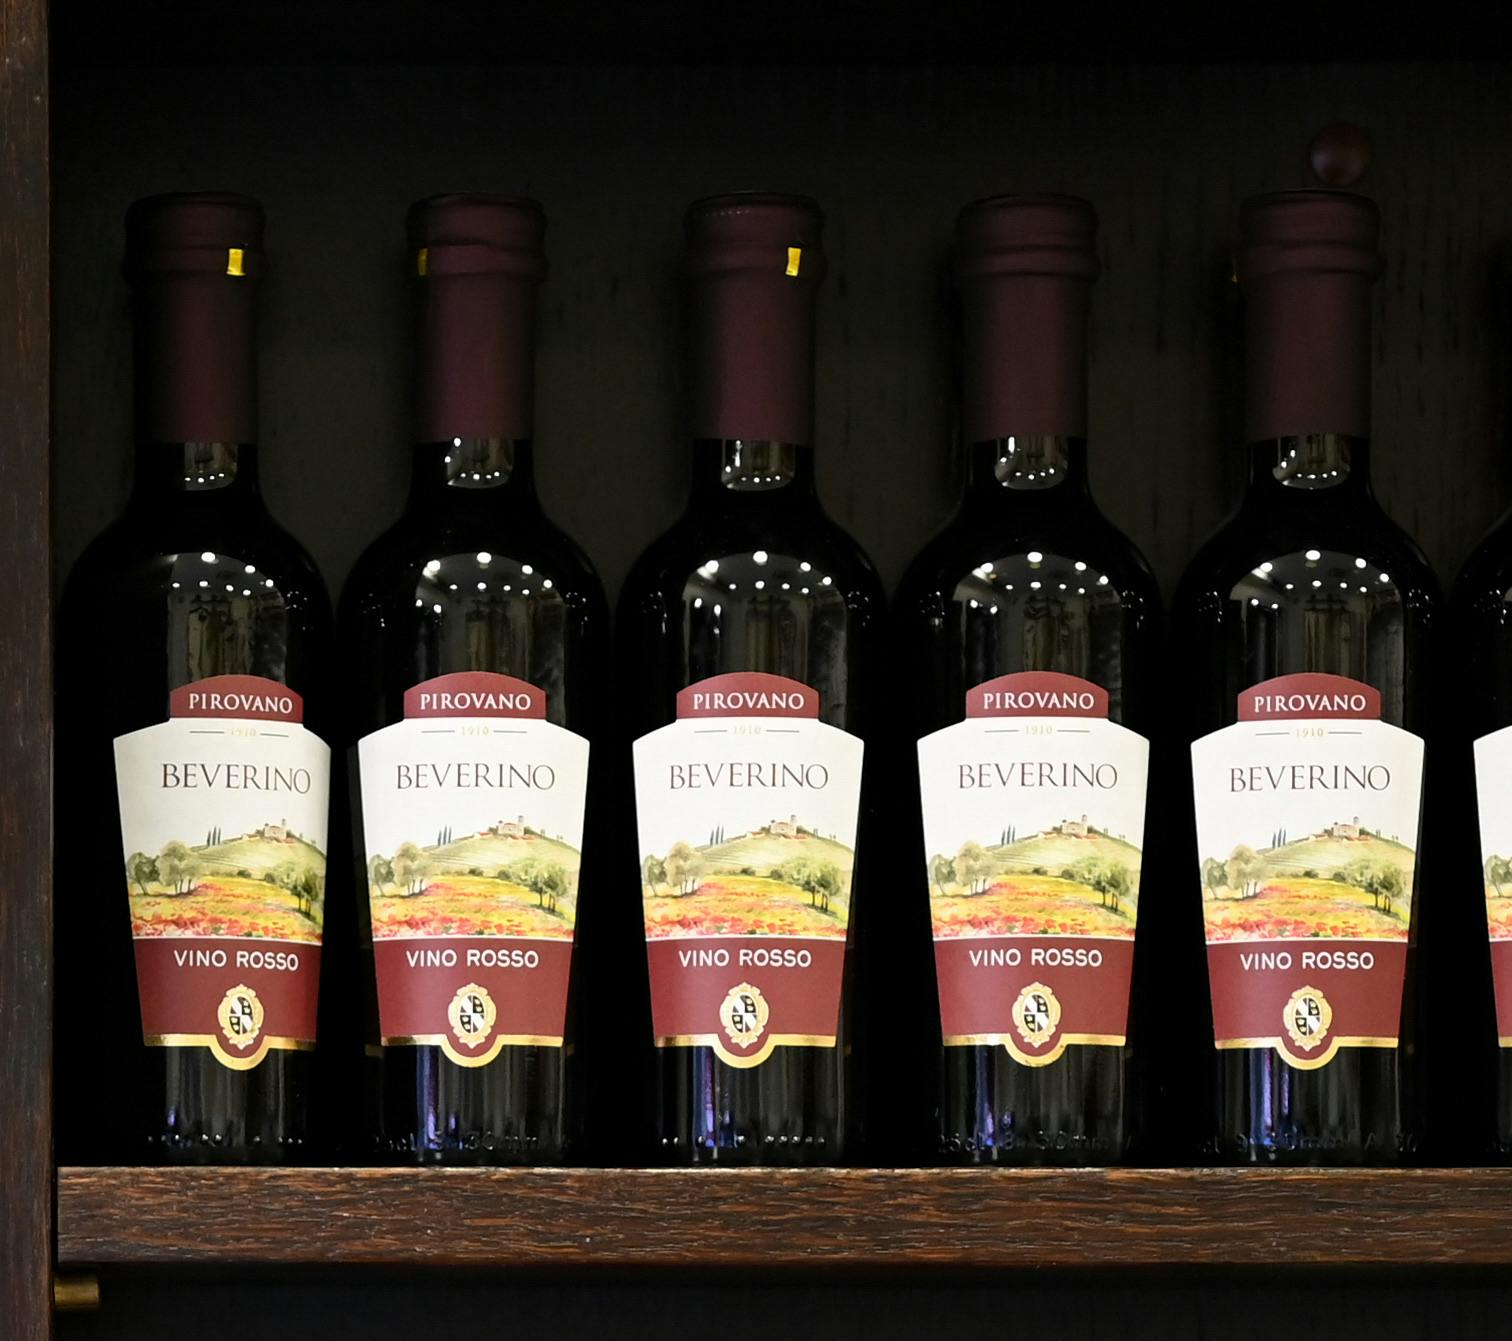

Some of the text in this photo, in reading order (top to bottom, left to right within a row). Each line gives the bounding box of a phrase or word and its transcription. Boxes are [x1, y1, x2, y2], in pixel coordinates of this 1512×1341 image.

[419, 693, 532, 711] PIROVANO
[395, 763, 556, 791] BEVERINO
[406, 949, 539, 968] VINO ROSSO
